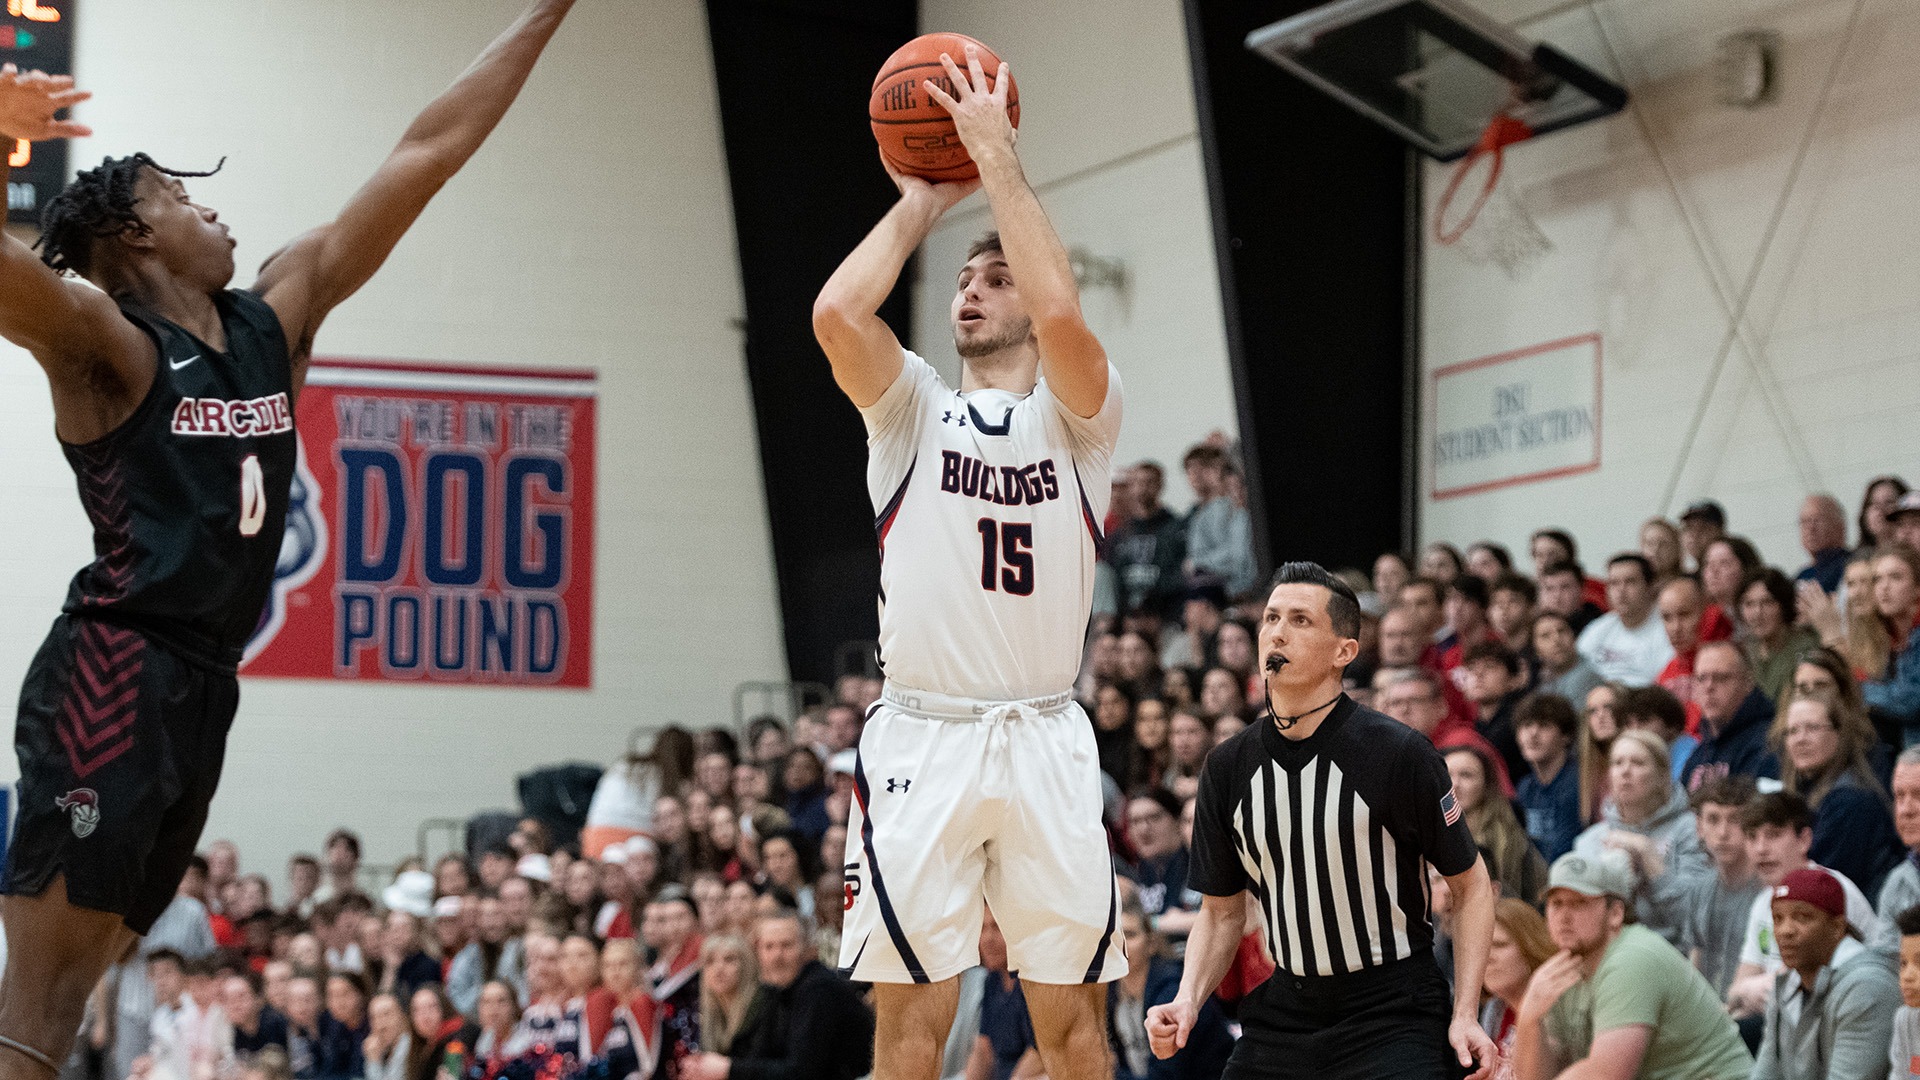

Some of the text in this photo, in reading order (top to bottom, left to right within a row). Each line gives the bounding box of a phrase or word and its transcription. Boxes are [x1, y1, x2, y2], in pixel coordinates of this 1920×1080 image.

[881, 79, 917, 112] THE
[171, 391, 293, 438] ARCDIA
[333, 395, 573, 450] YOU'RE IN THE
[239, 453, 266, 537] 0
[941, 449, 1060, 506] BULLDGS
[336, 444, 571, 592] DOG
[977, 516, 1035, 597] 15
[334, 587, 568, 679] POUND
